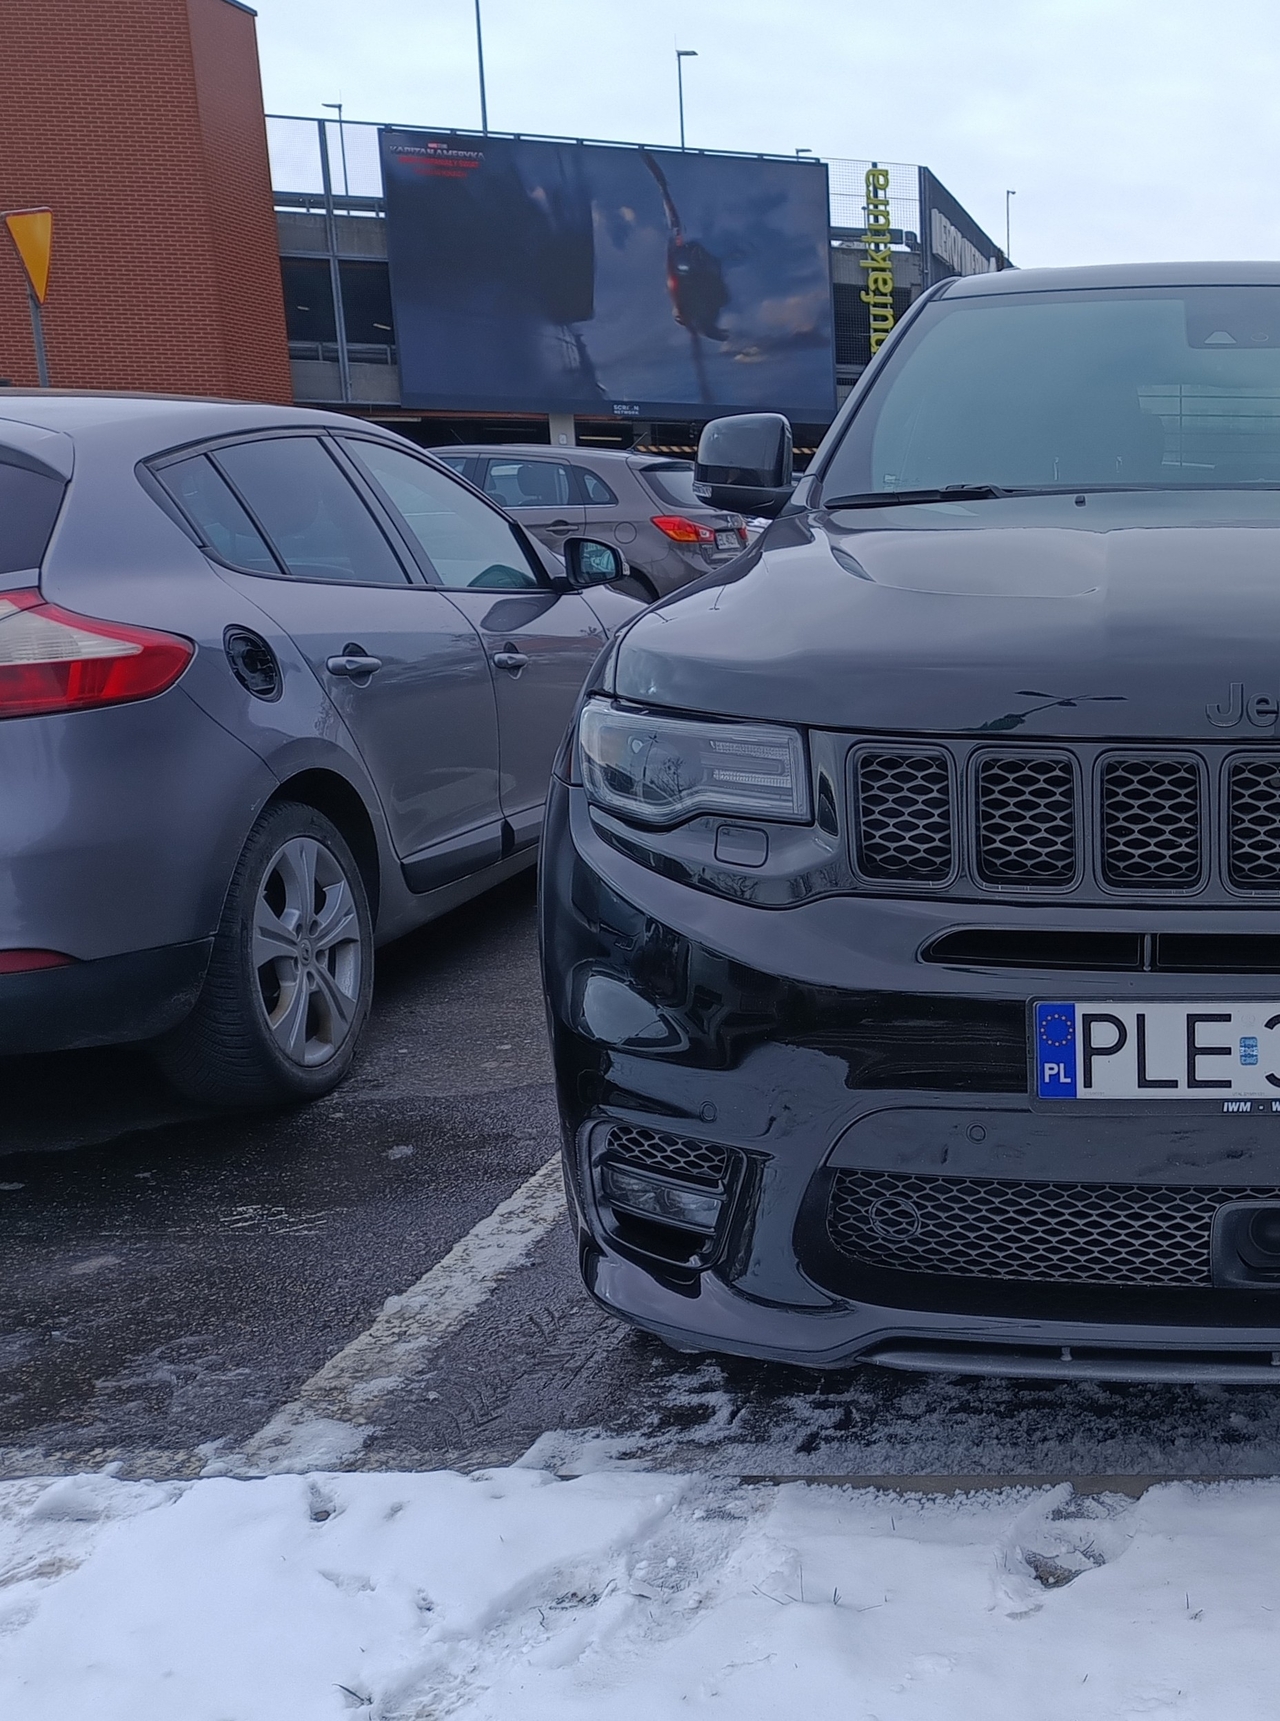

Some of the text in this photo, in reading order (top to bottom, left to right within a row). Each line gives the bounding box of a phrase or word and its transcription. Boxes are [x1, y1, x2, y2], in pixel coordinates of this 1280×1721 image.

[1082, 1013, 1233, 1089] PLE
[1044, 1062, 1072, 1083] PL
[1223, 1101, 1251, 1112] IWM
